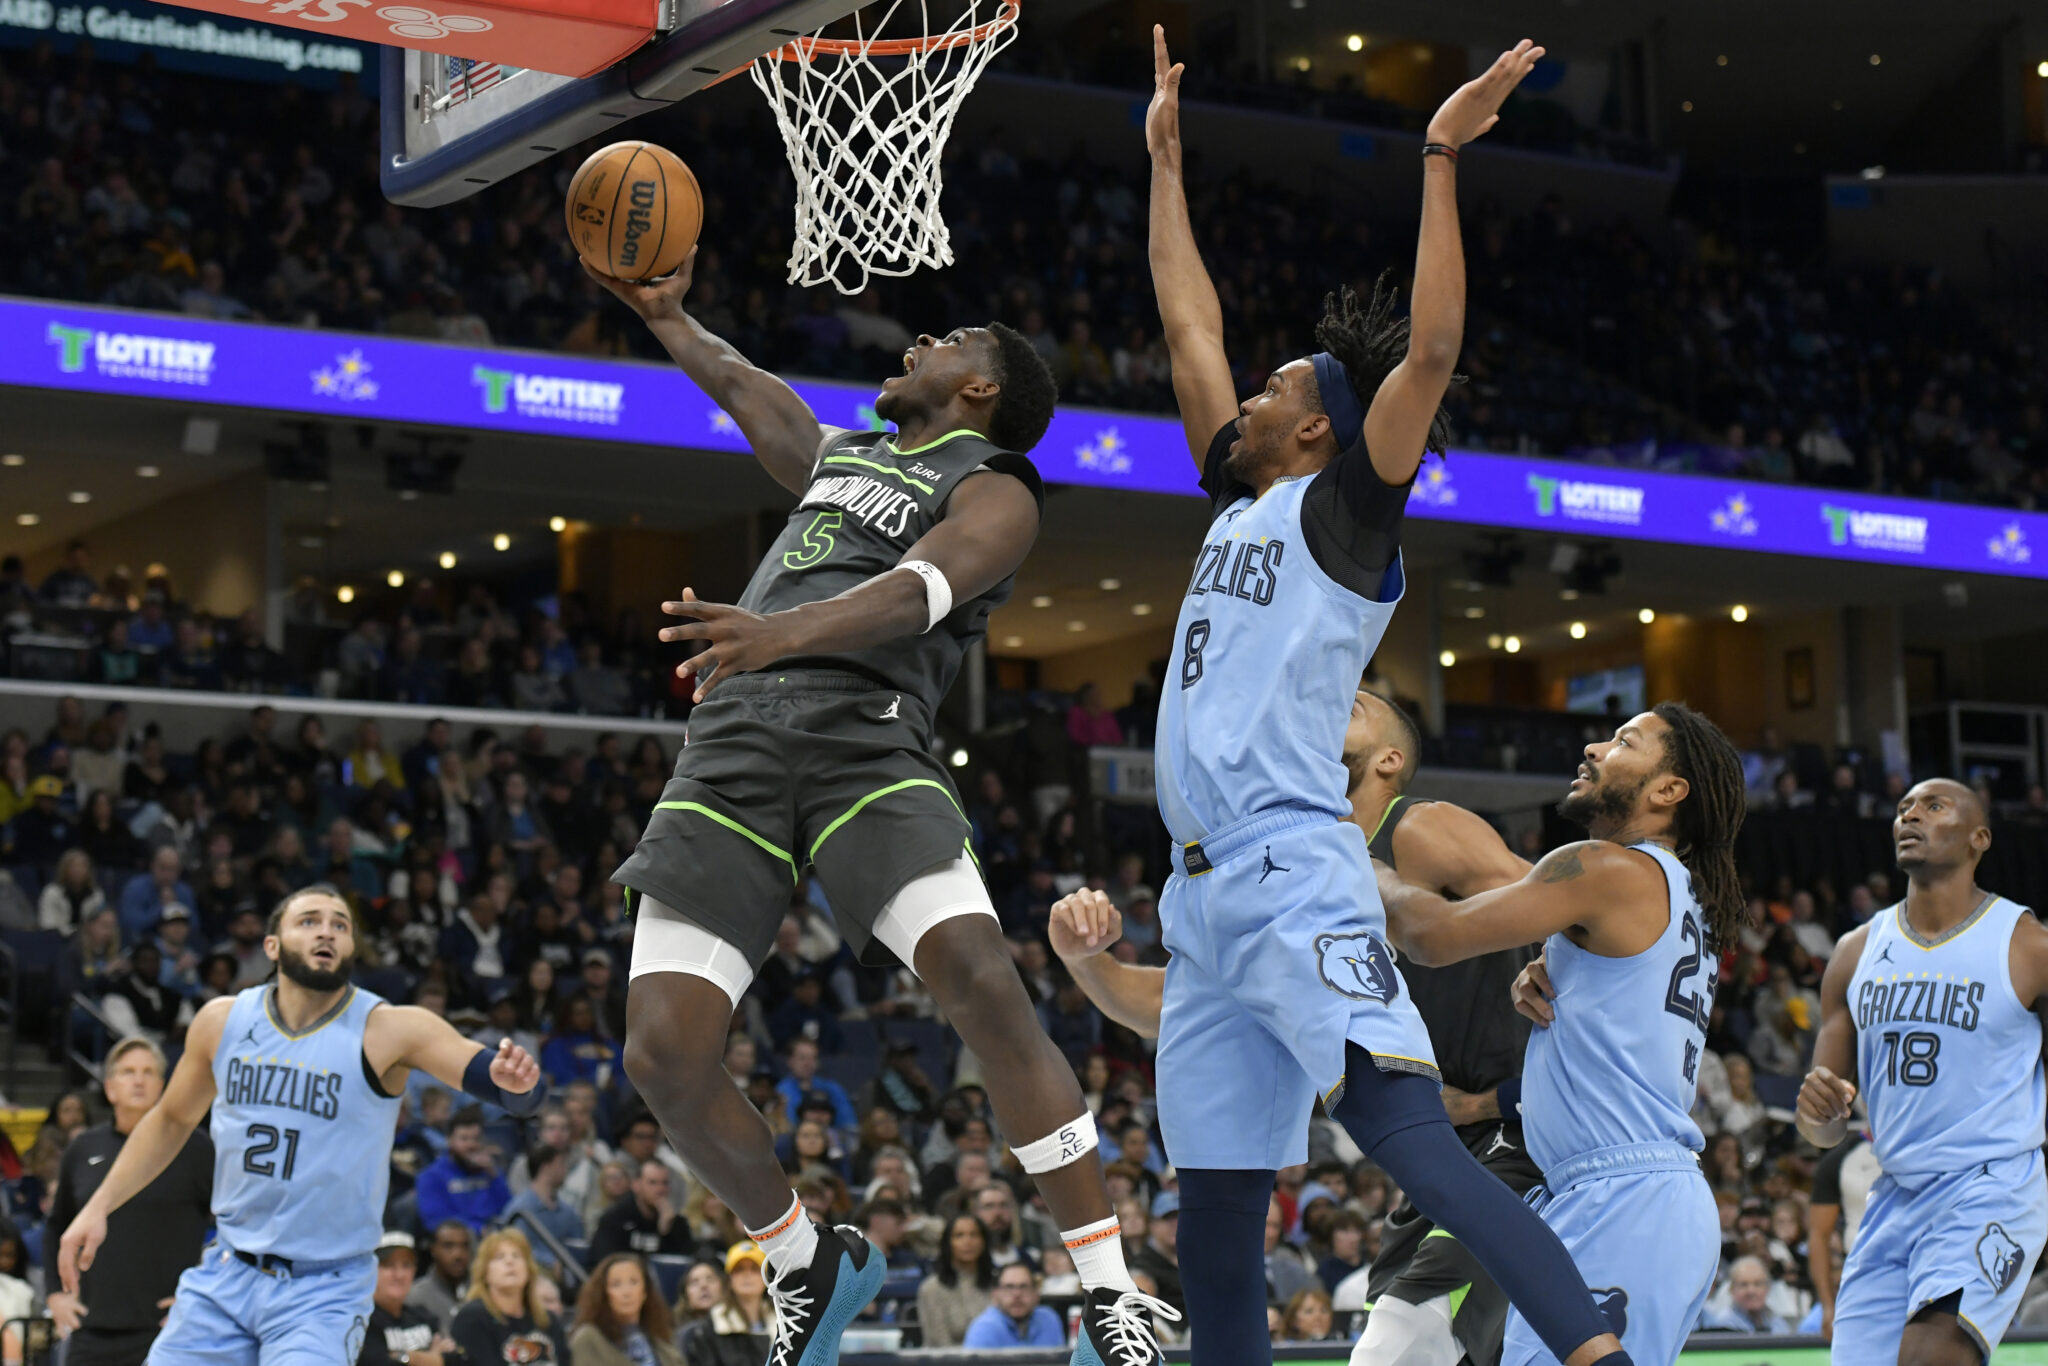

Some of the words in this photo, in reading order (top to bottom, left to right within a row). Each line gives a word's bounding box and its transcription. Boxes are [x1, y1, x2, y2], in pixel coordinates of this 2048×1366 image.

[56, 7, 85, 34] at
[86, 6, 363, 73] GrizzliesBanking.com
[619, 180, 657, 267] Wilson
[95, 331, 216, 371] LOTTERY
[513, 373, 624, 410] LOTTERY
[1560, 479, 1644, 514] LOTTERY
[783, 511, 843, 570] 5
[1850, 509, 1928, 543] LOTTERY
[1181, 618, 1211, 691] 8
[1664, 909, 1721, 1039] 23
[1857, 980, 1985, 1032] GRIZZLIES
[1883, 1031, 1941, 1087] 18
[226, 1057, 342, 1121] GRIZZLIES
[244, 1123, 301, 1181] 21
[1060, 1126, 1076, 1145] 5
[1061, 1138, 1086, 1162] AE
